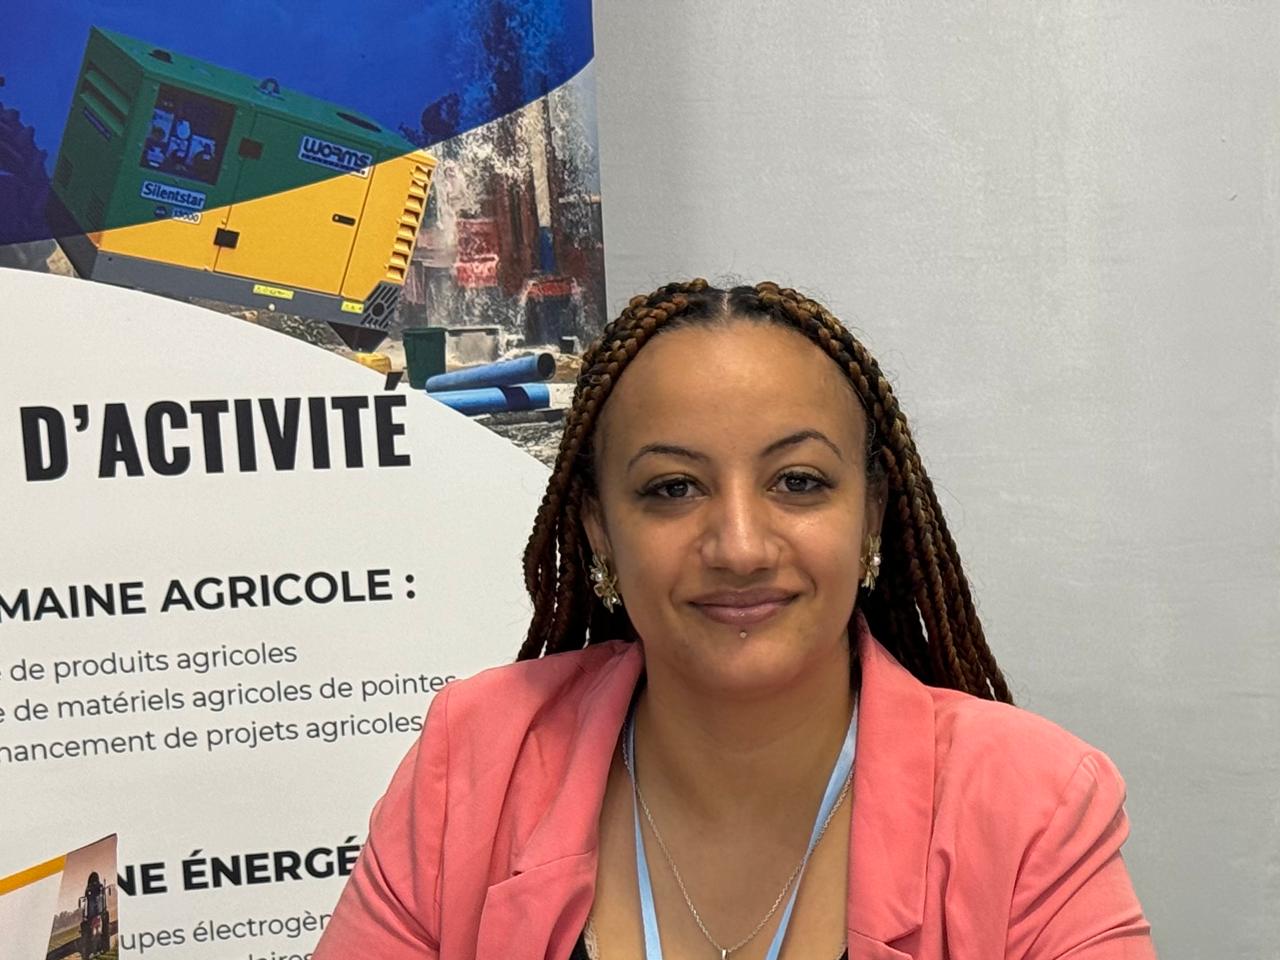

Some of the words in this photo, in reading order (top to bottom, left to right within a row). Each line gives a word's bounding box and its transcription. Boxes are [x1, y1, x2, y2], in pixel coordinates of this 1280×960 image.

[144, 182, 205, 207] Silentstar
[160, 569, 393, 613] AGRICOLE
[10, 658, 45, 682] de
[54, 650, 169, 684] produits
[177, 642, 298, 674] agricoles
[14, 698, 49, 722] de
[58, 687, 185, 719] matériels
[192, 680, 312, 712] agricoles
[319, 677, 353, 700] de
[164, 727, 198, 750] de
[206, 719, 299, 751] projets
[305, 712, 424, 742] agricoles
